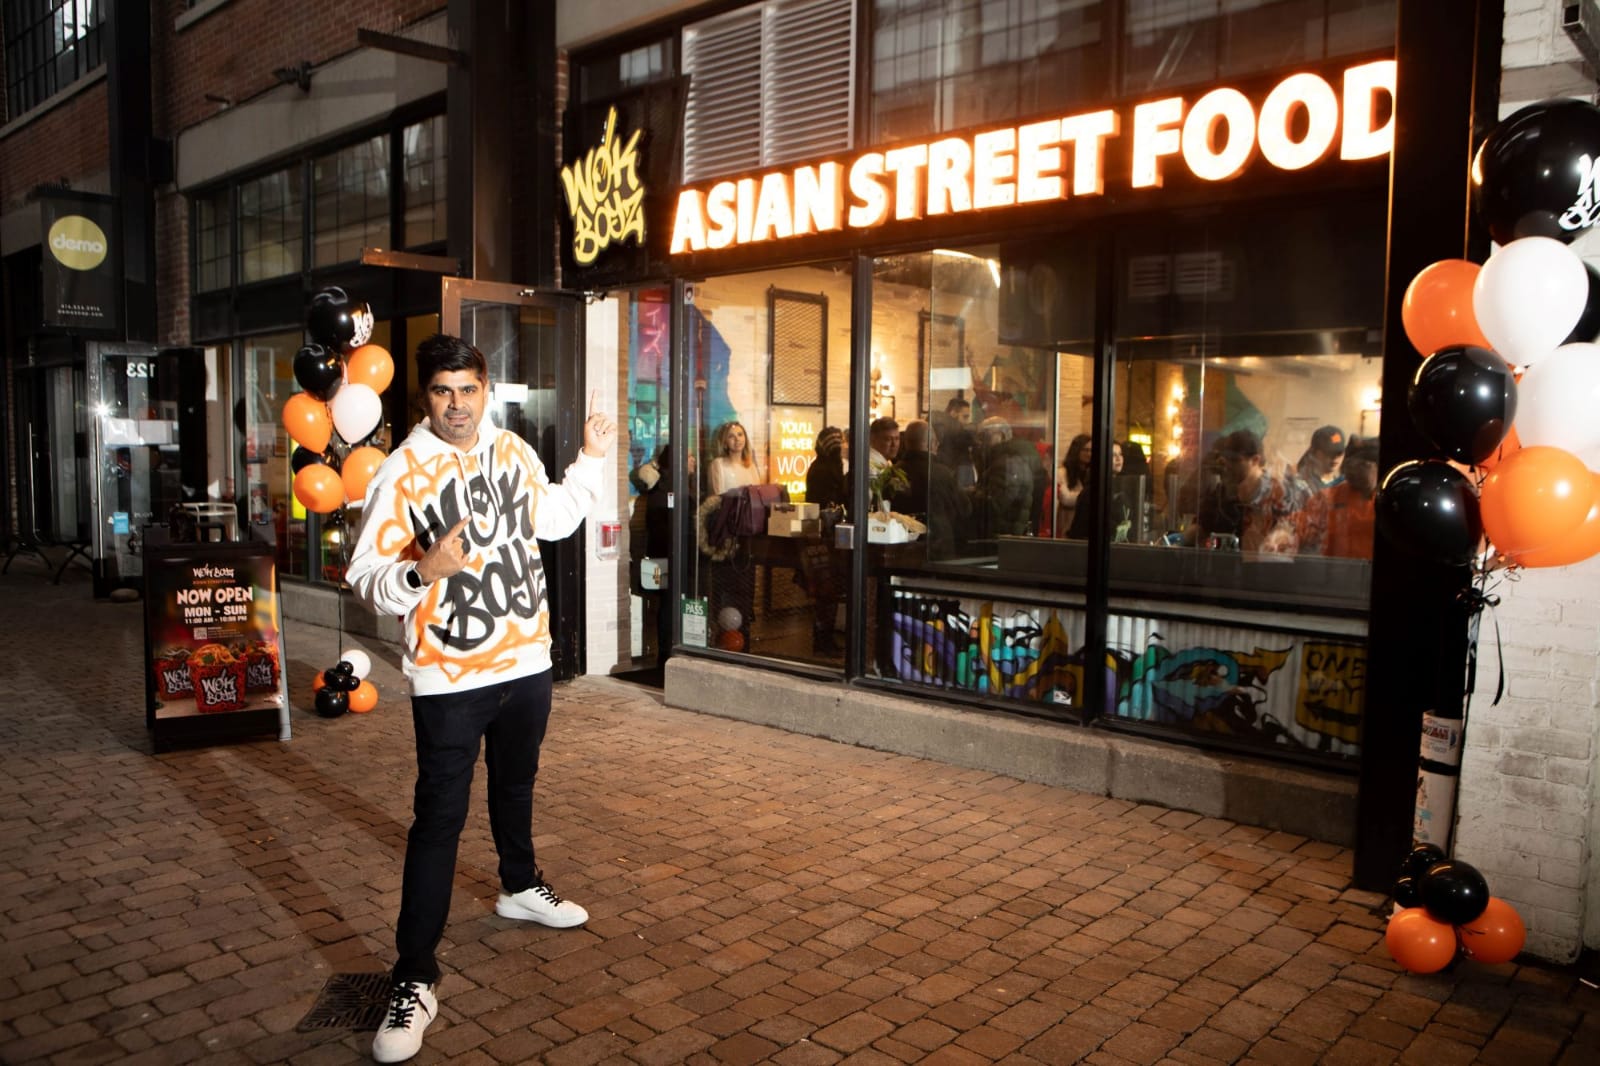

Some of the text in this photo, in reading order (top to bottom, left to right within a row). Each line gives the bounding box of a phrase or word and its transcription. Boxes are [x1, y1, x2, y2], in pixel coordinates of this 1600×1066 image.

[561, 105, 641, 217] WOK
[669, 59, 1397, 255] ASIAN STREET FOOD
[52, 233, 103, 254] demo
[781, 438, 813, 450] NEVER
[177, 586, 254, 605] NOW OPEN
[184, 606, 212, 618] MON
[223, 605, 247, 616] SUN
[685, 603, 704, 616] PASS
[1306, 650, 1367, 680] ONE
[201, 668, 237, 693] WOK
